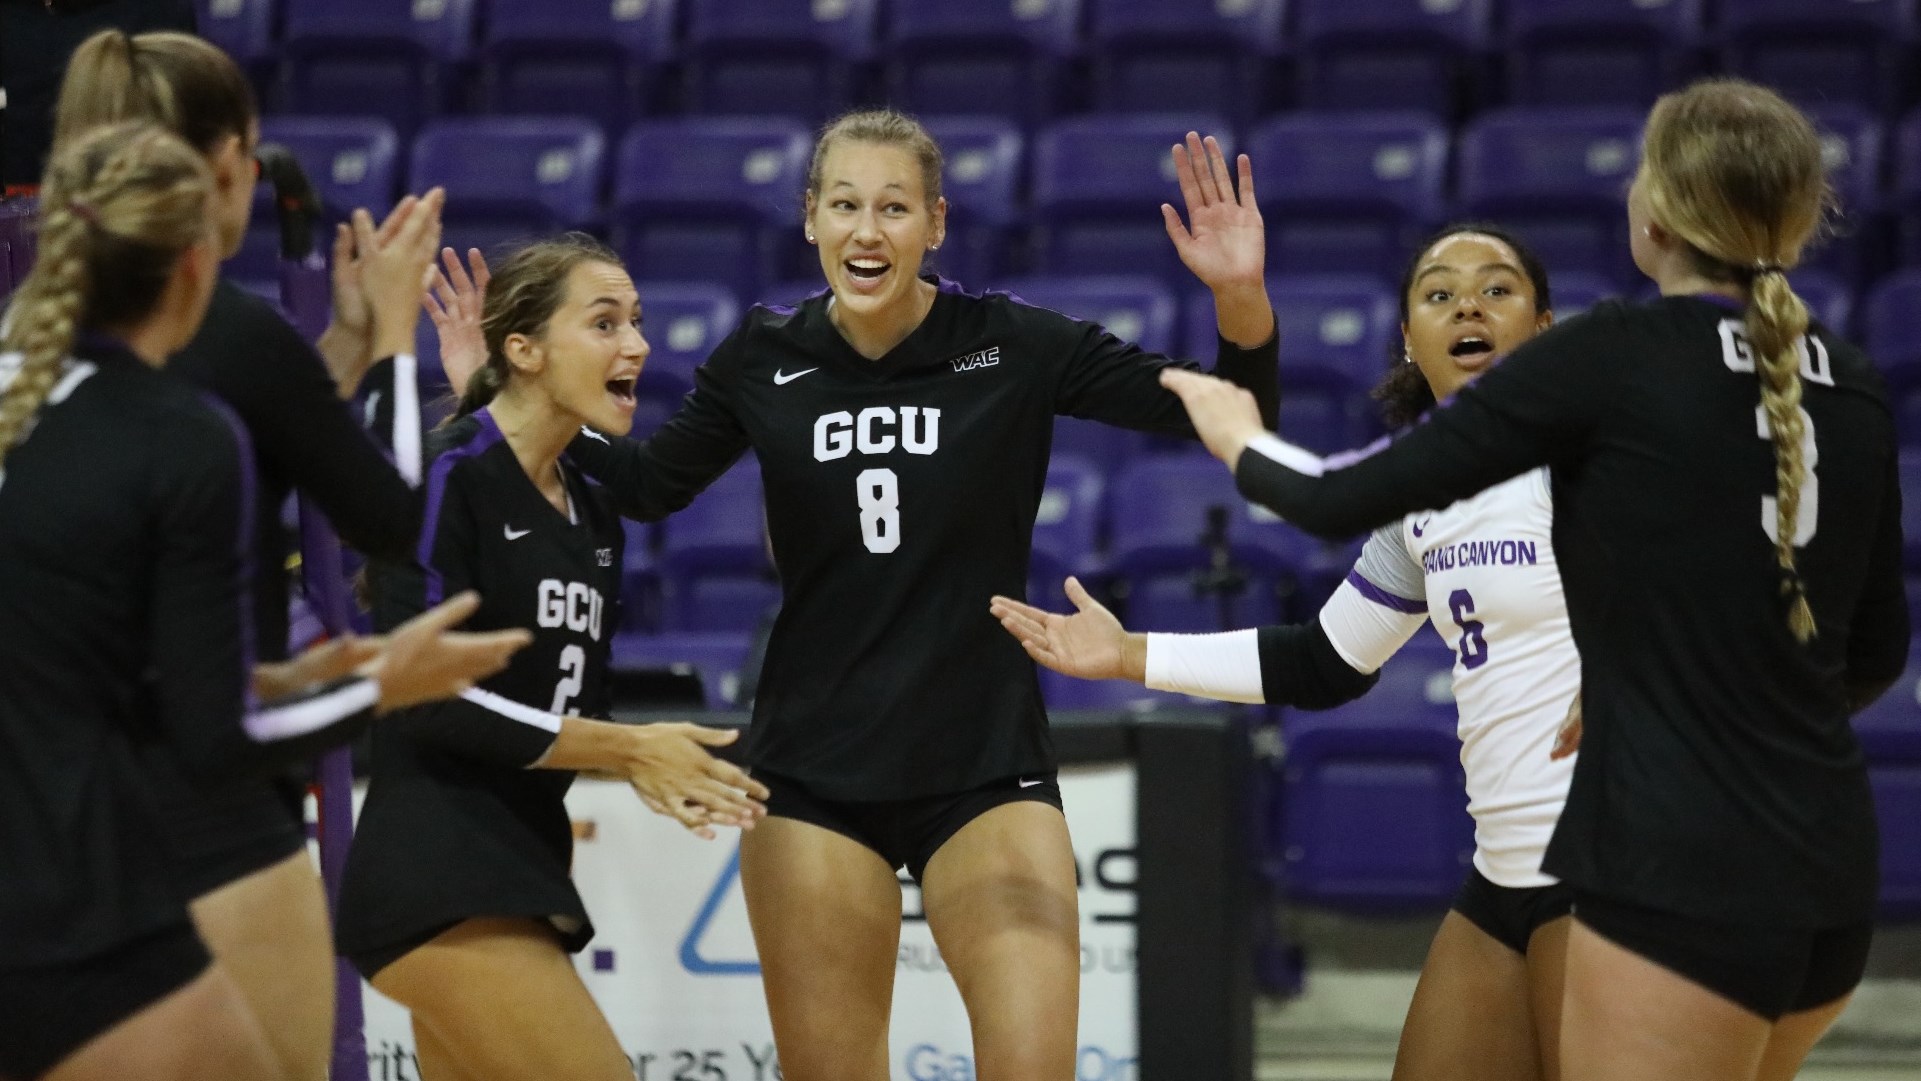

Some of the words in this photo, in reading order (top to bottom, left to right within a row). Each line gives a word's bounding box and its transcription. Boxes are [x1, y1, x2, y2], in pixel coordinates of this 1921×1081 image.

[950, 346, 999, 372] WAC
[1717, 318, 1835, 387] GU
[814, 406, 941, 462] GCU
[856, 468, 900, 553] 8
[1458, 540, 1537, 567] CANYON
[537, 578, 604, 642] GCU
[1448, 588, 1488, 670] 6
[549, 644, 586, 717] 2
[672, 1048, 727, 1081] 25
